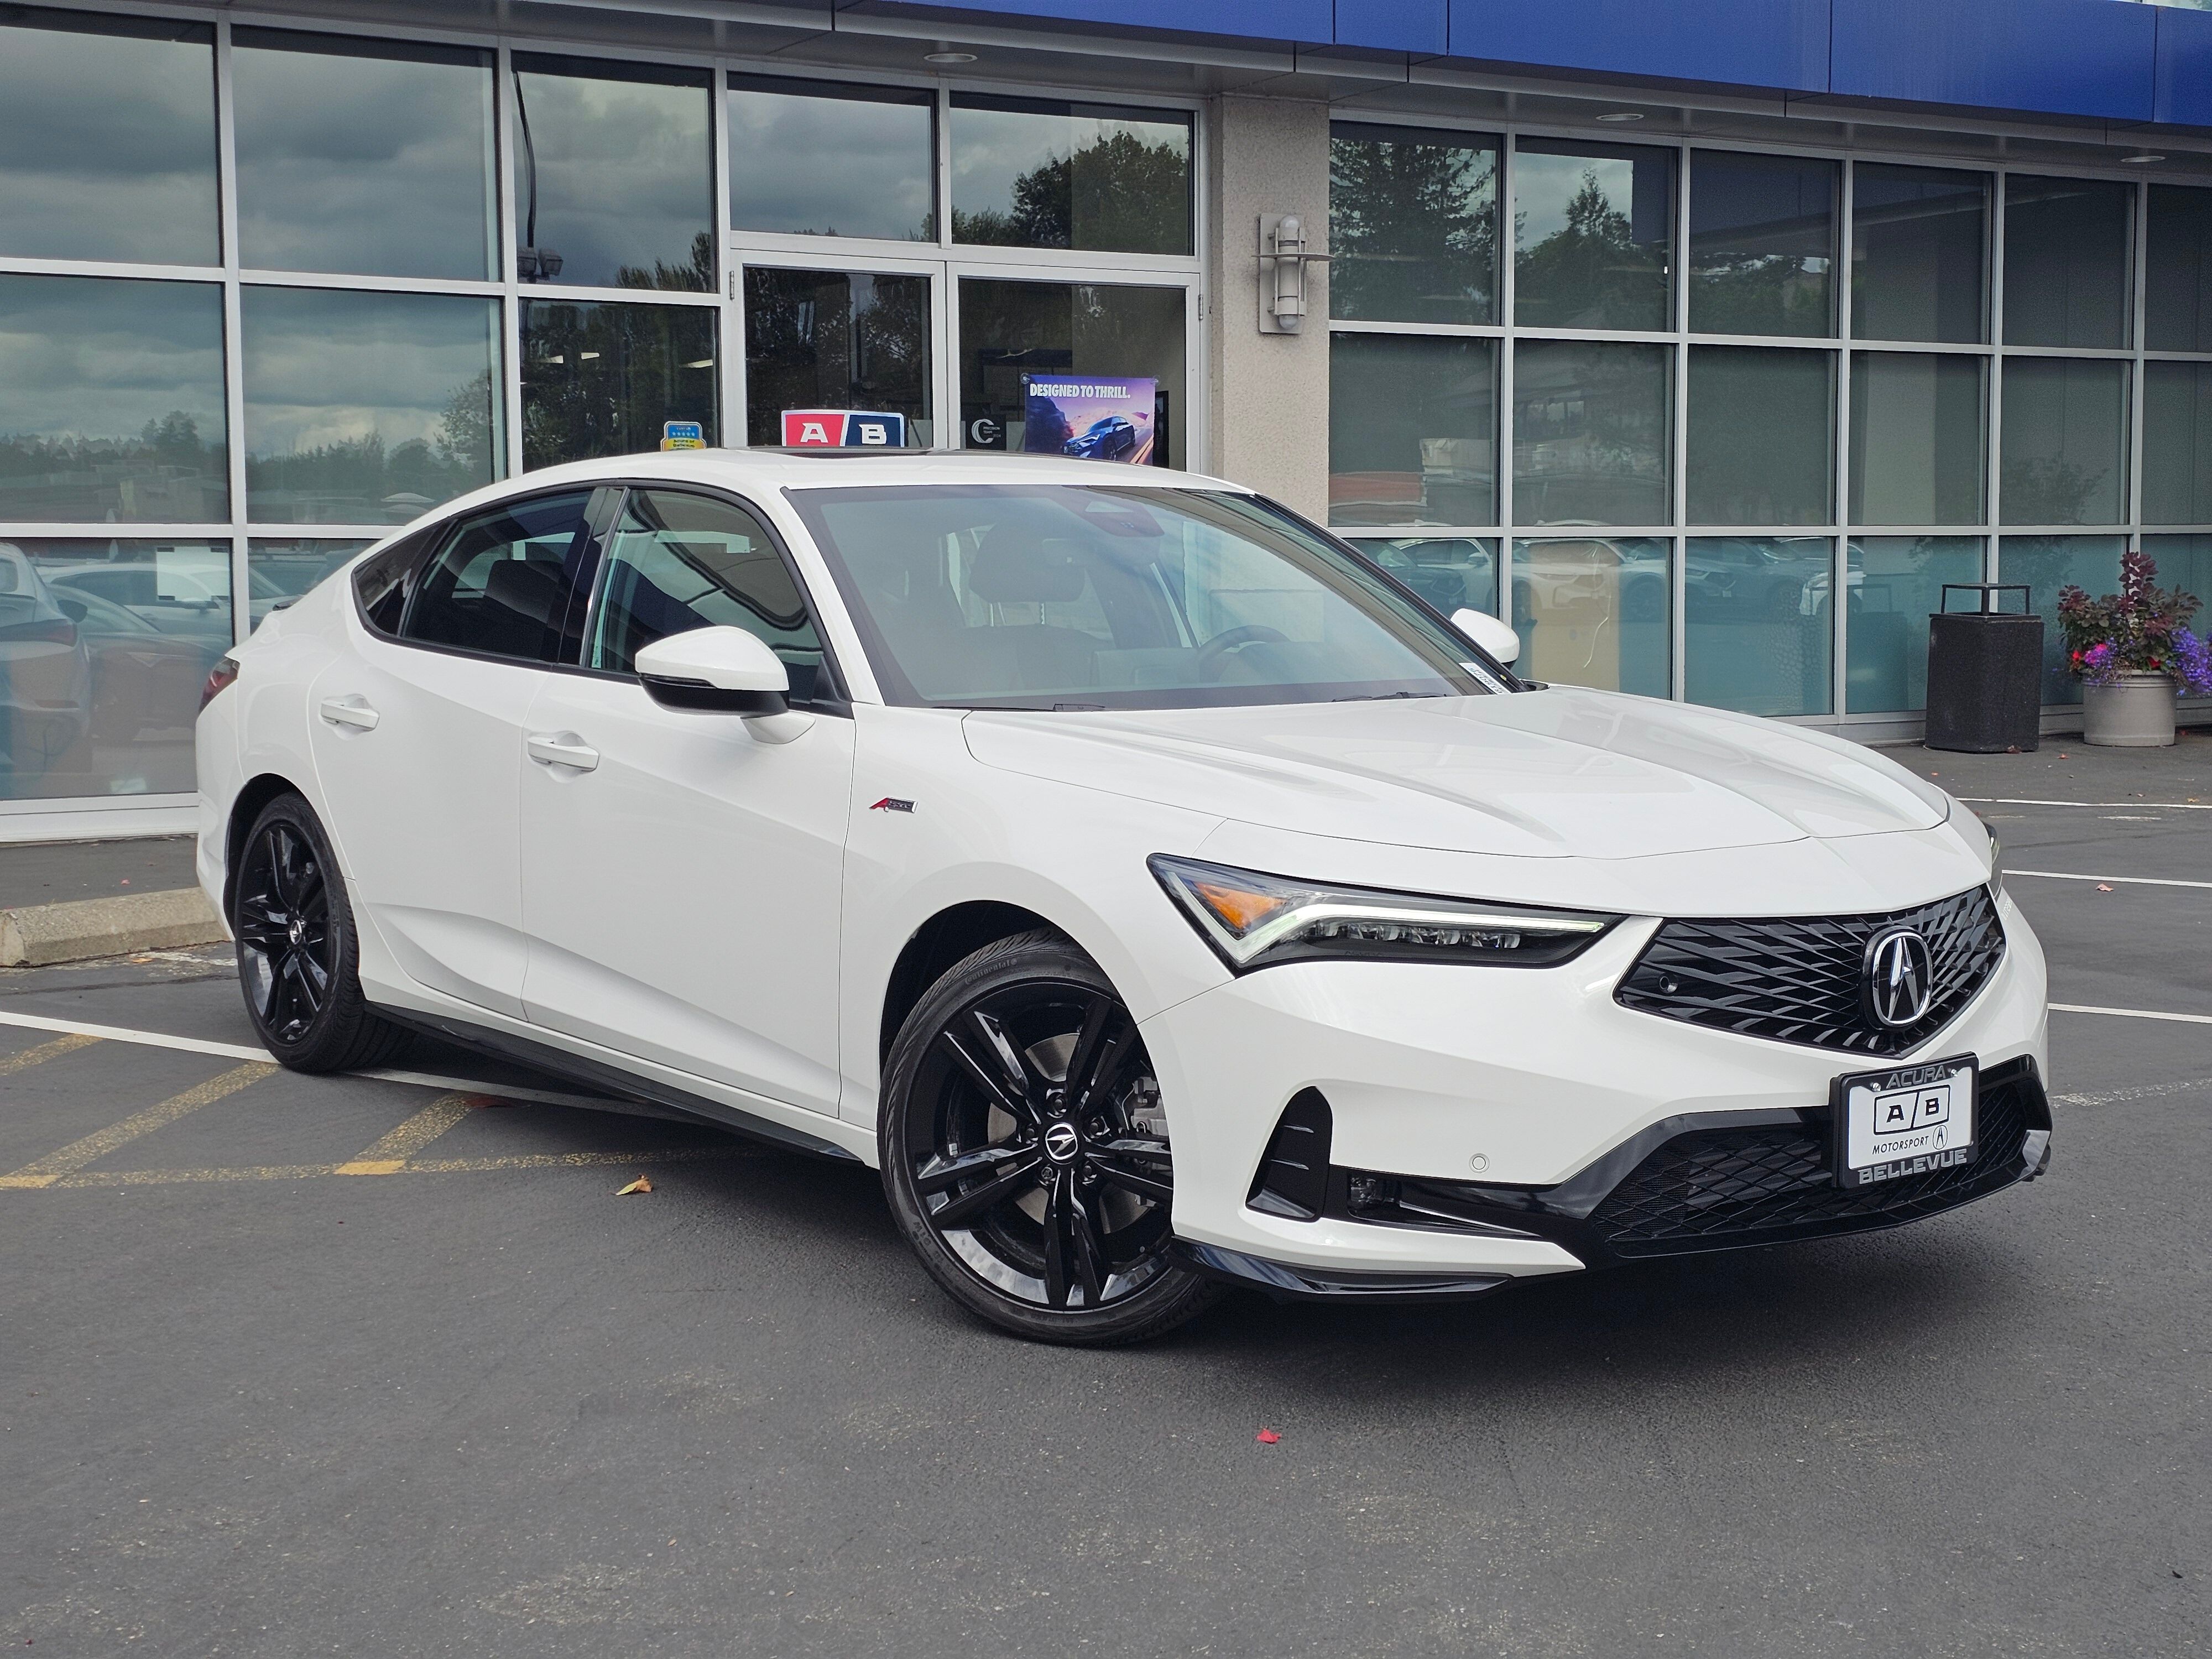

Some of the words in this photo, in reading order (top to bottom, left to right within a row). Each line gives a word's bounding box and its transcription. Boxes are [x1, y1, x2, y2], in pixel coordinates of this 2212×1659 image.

[1030, 383, 1079, 397] DESIGNED
[1081, 385, 1093, 398] TO
[1095, 385, 1131, 399] THRILL.
[800, 422, 828, 443] A
[859, 424, 886, 445] B
[1886, 1065, 1947, 1089] ACURA
[1886, 1104, 1905, 1123] A
[1925, 1097, 1939, 1116] B
[1872, 1135, 1929, 1155] MOTORSPORT
[1858, 1149, 1967, 1185] BELLEVUE
